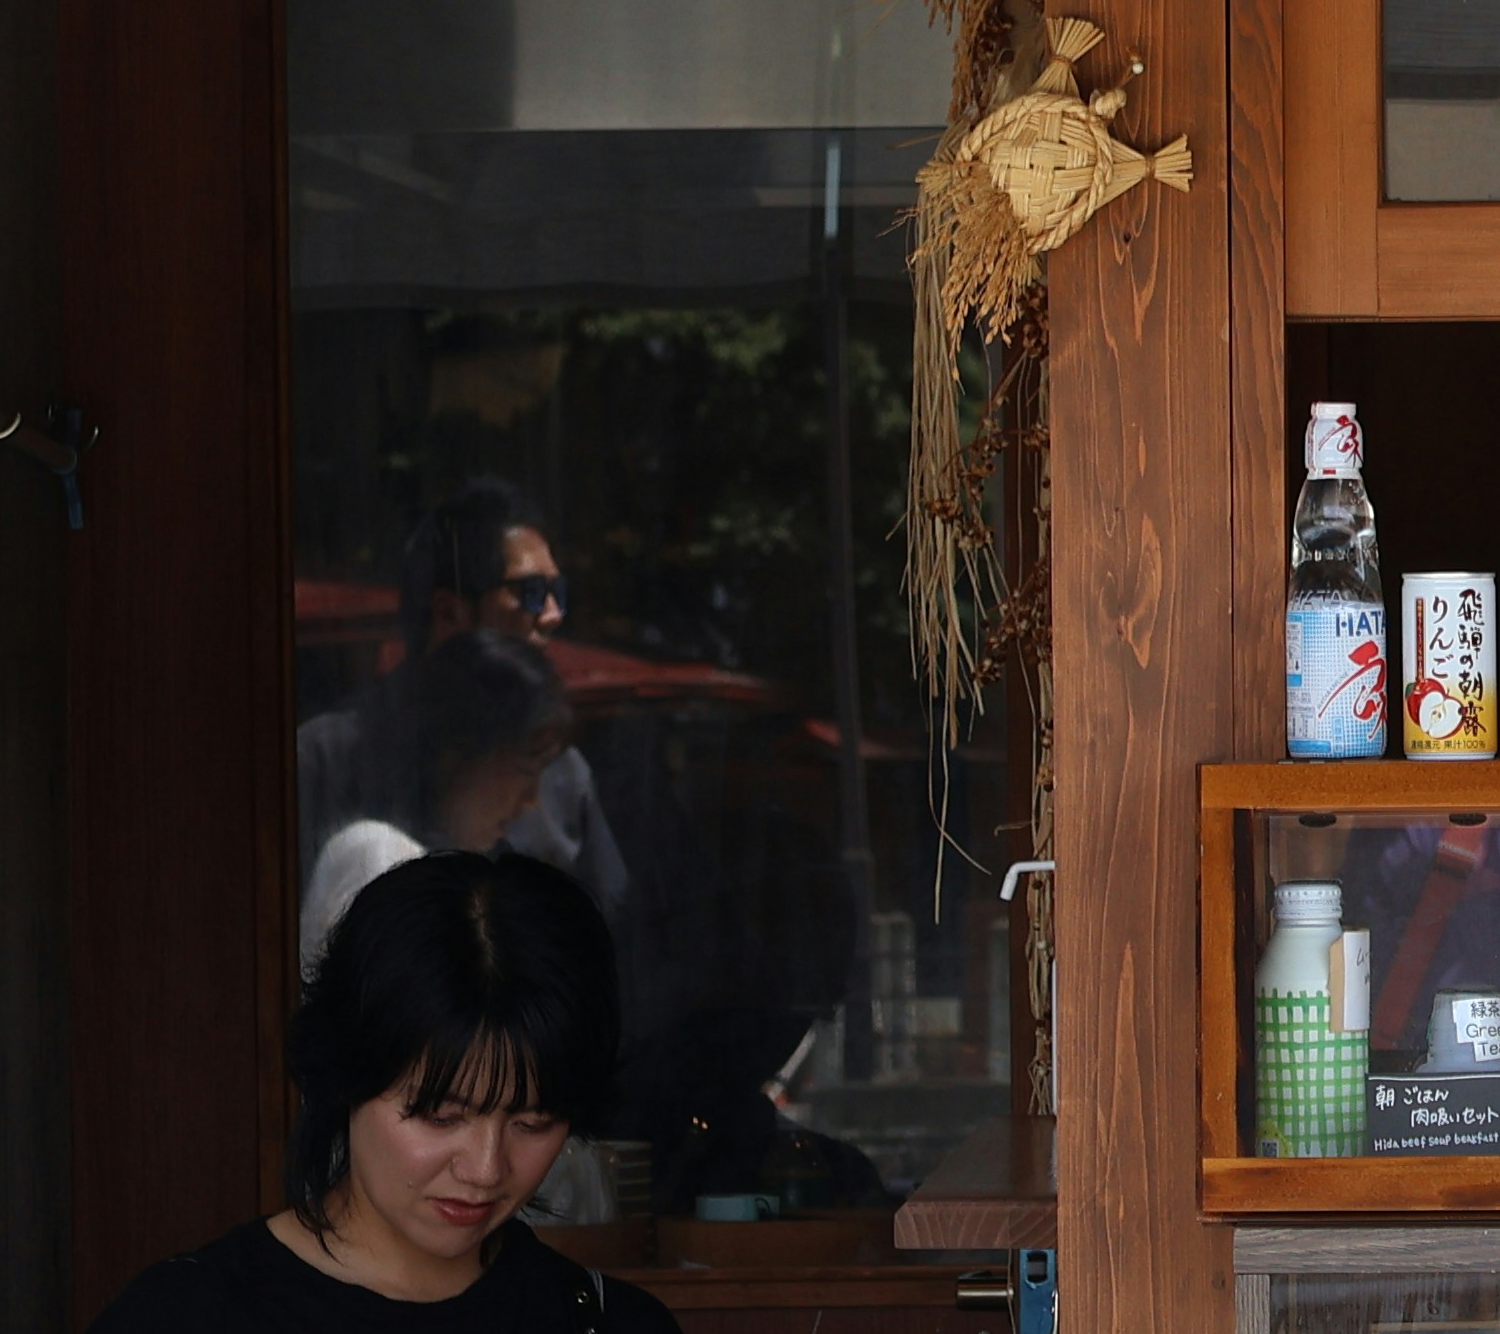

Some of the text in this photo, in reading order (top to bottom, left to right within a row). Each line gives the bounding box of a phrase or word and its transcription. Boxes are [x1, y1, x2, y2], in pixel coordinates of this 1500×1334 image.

[1429, 595, 1454, 680] りんご
[1457, 588, 1486, 738] 飛騨の朝露
[1470, 1000, 1500, 1019] 緑茶
[1375, 1084, 1450, 1111] 朝ごはん
[1411, 1106, 1500, 1128] 肉吸いセット
[1401, 1137, 1427, 1149] beef
